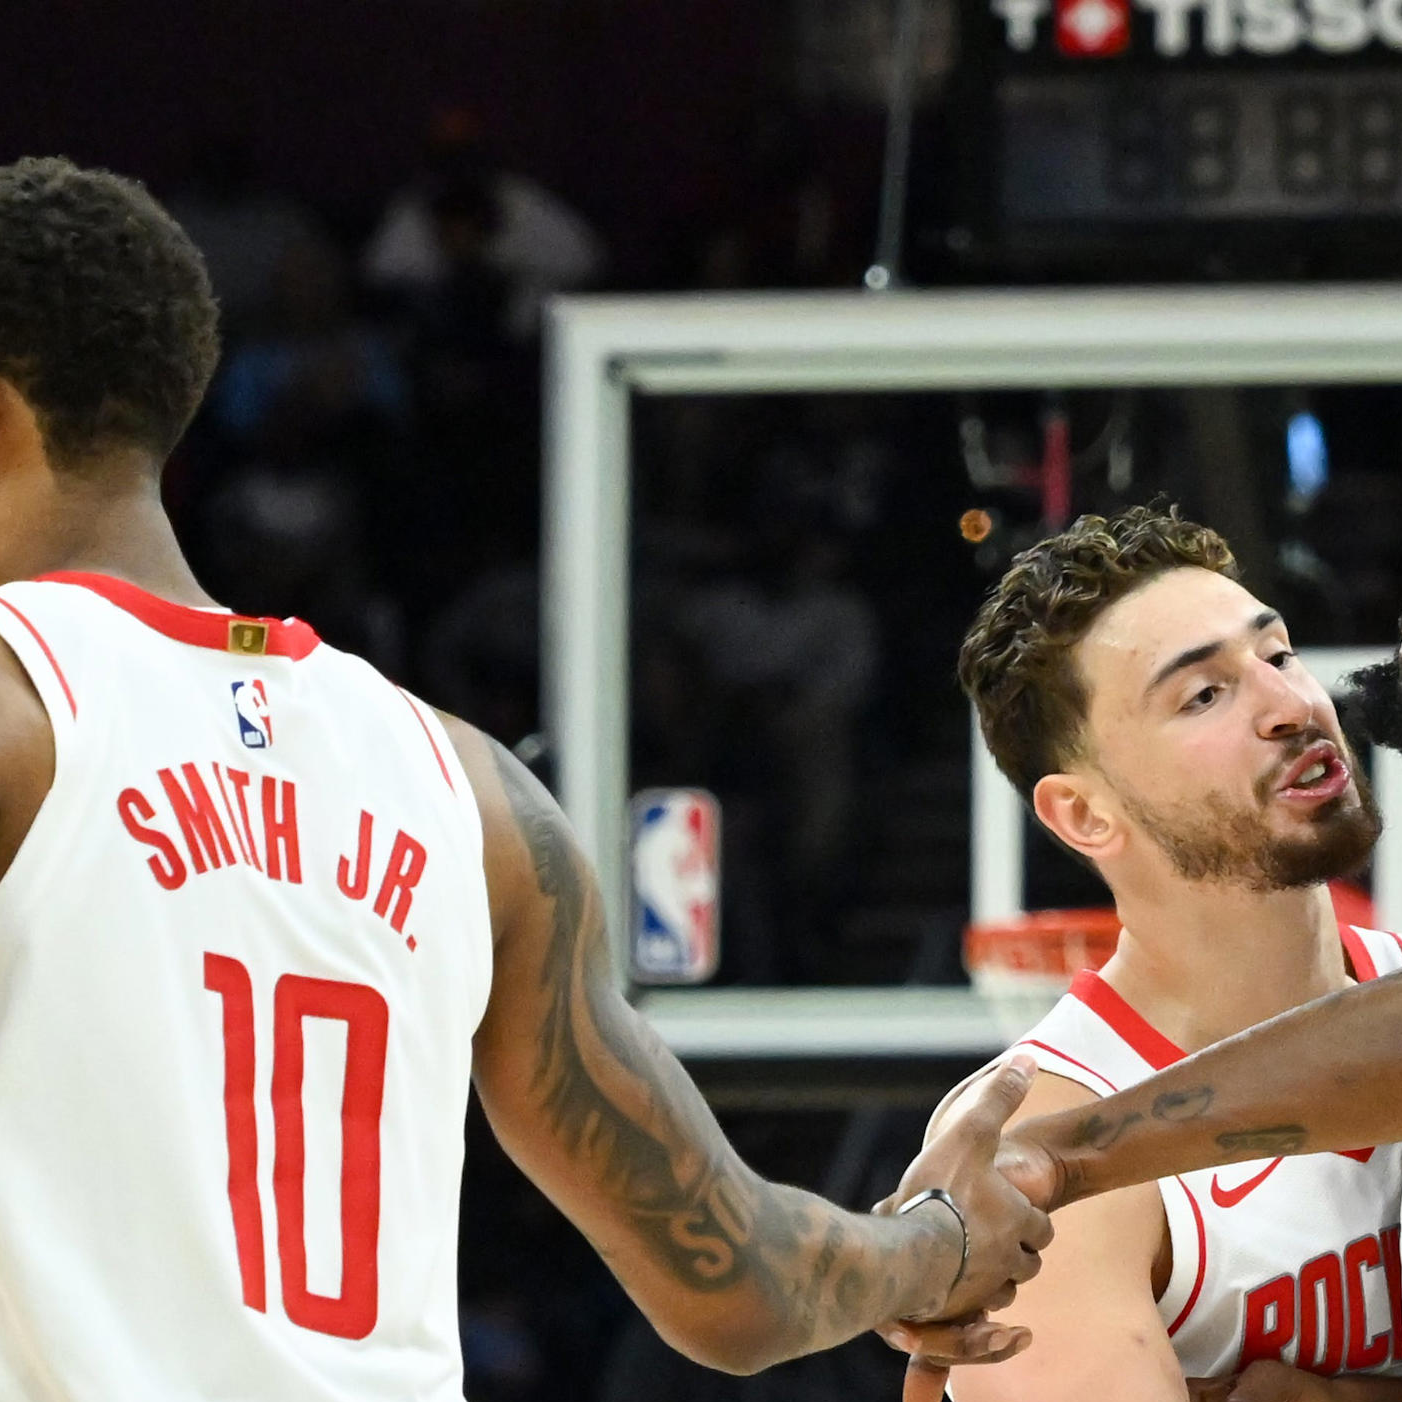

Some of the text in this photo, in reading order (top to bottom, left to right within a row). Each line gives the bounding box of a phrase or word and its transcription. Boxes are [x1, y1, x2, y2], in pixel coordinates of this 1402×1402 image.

[117, 761, 427, 952] SMITH JR.
[204, 951, 389, 1341] 10
